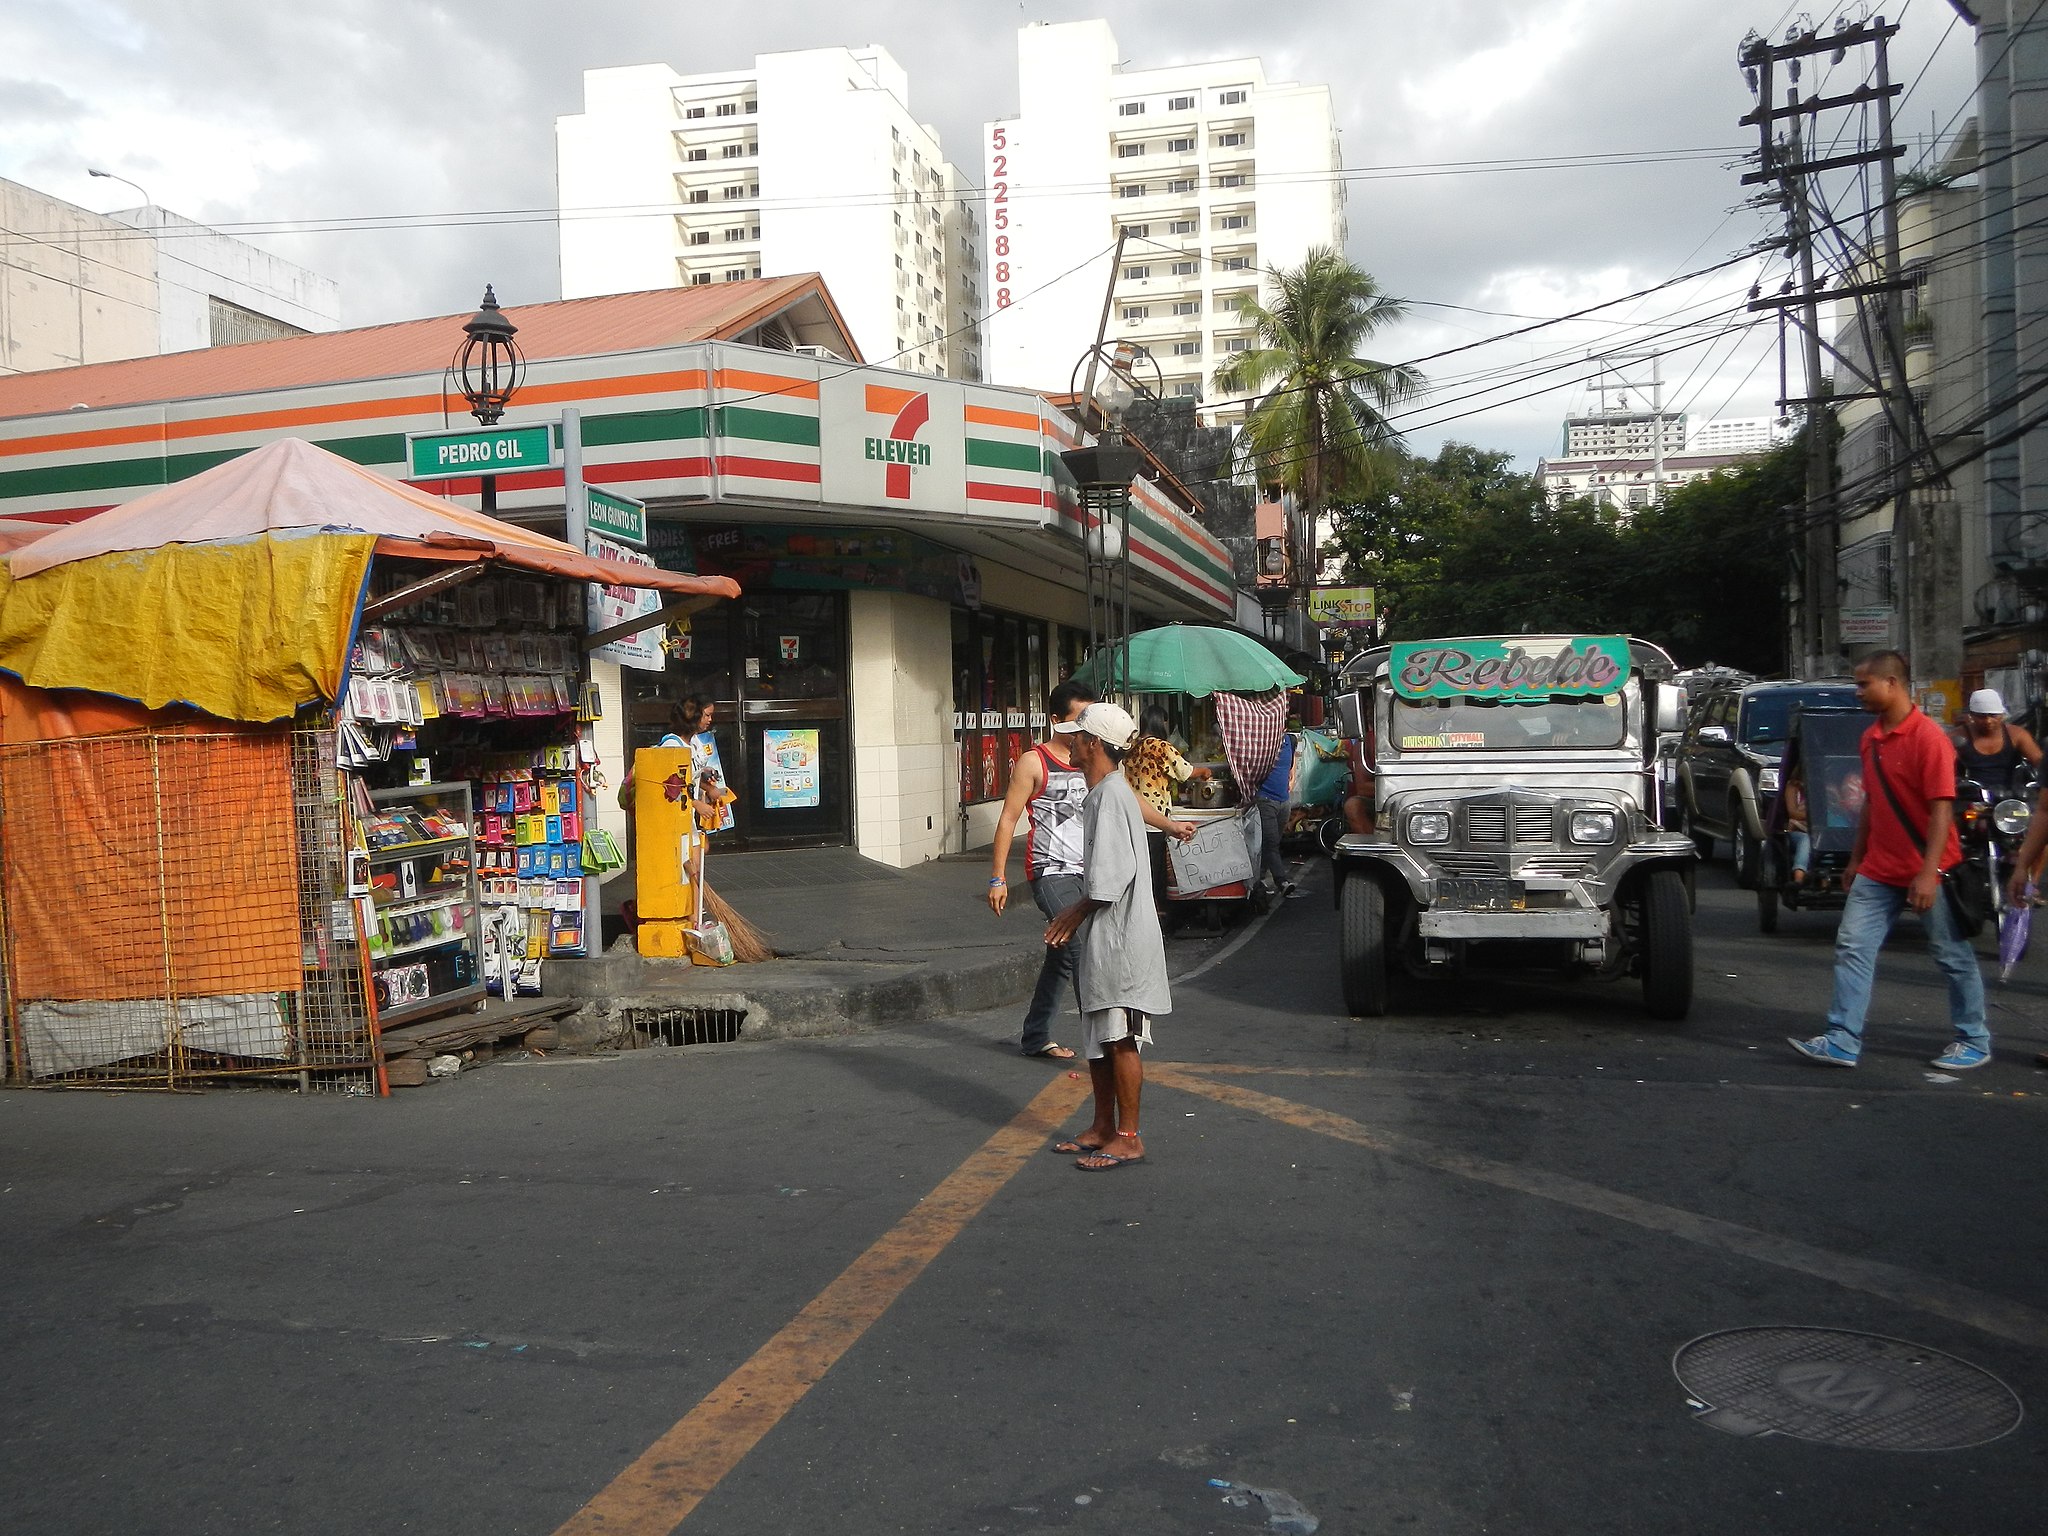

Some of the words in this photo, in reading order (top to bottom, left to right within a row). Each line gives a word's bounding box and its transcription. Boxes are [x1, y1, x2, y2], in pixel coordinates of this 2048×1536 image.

[992, 128, 1011, 309] 5225888
[438, 441, 491, 465] PEDRO
[495, 439, 523, 460] GIL
[864, 383, 930, 500] 7
[590, 500, 607, 523] LEON
[708, 530, 739, 549] FREE
[1400, 644, 1621, 690] Rebelde
